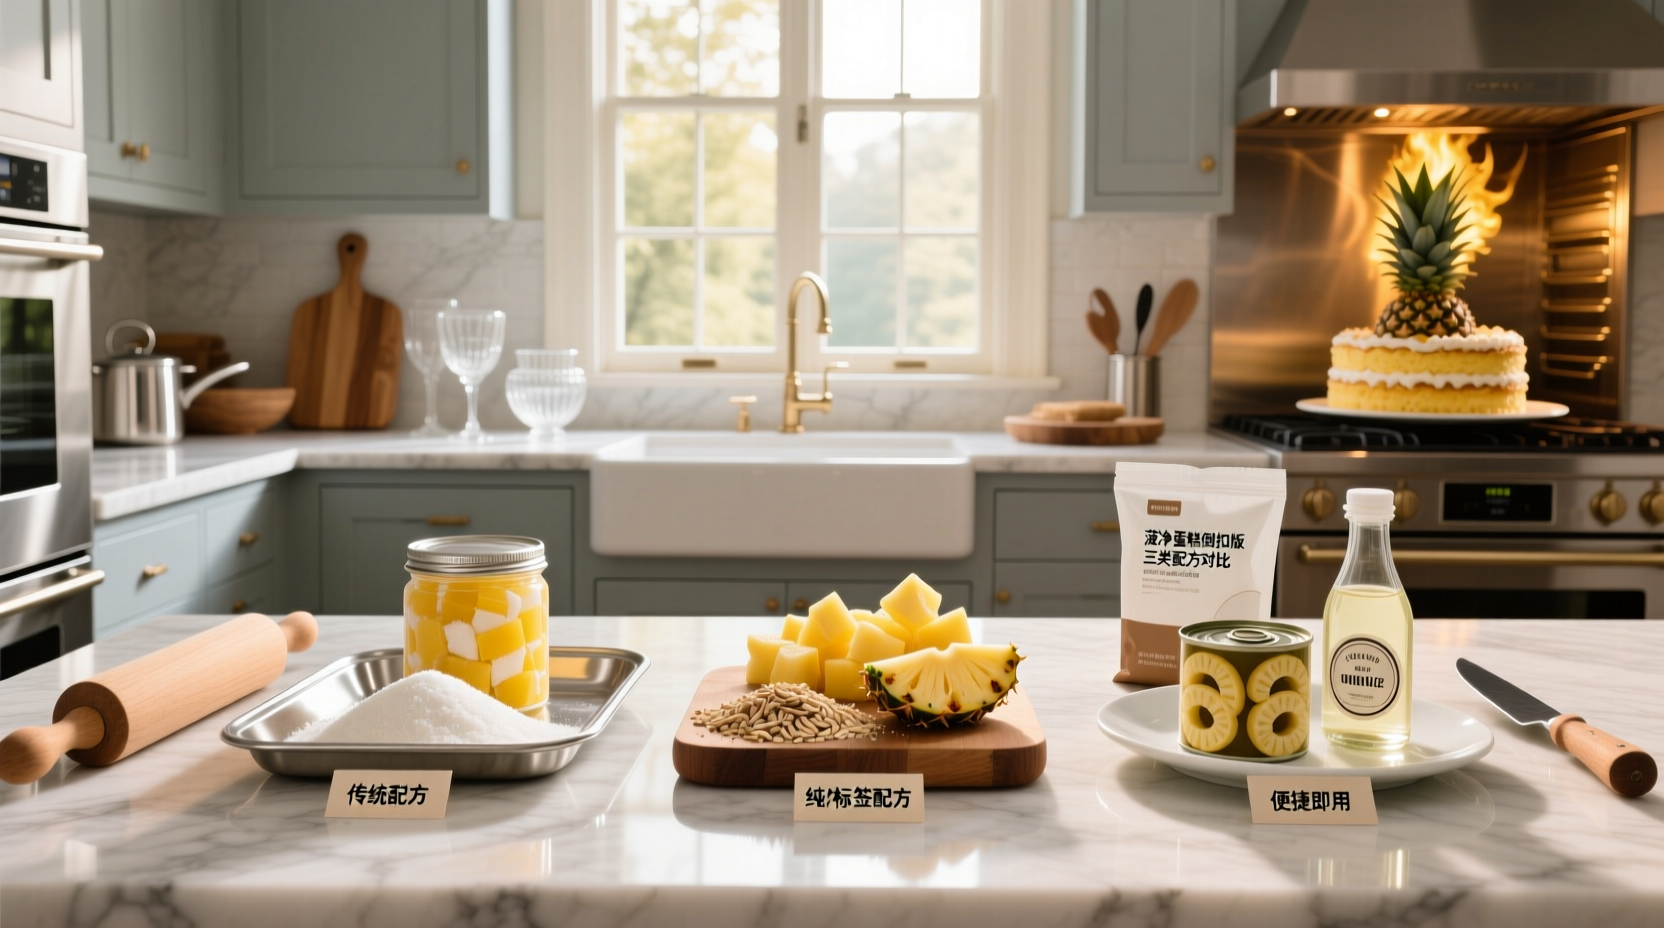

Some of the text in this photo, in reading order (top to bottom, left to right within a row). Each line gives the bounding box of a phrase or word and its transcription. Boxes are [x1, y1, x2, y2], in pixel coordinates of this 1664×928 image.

[1143, 549, 1231, 569] 三类配方对比
[347, 782, 429, 807] 传统配方
[1270, 789, 1351, 812] 便捷即用
